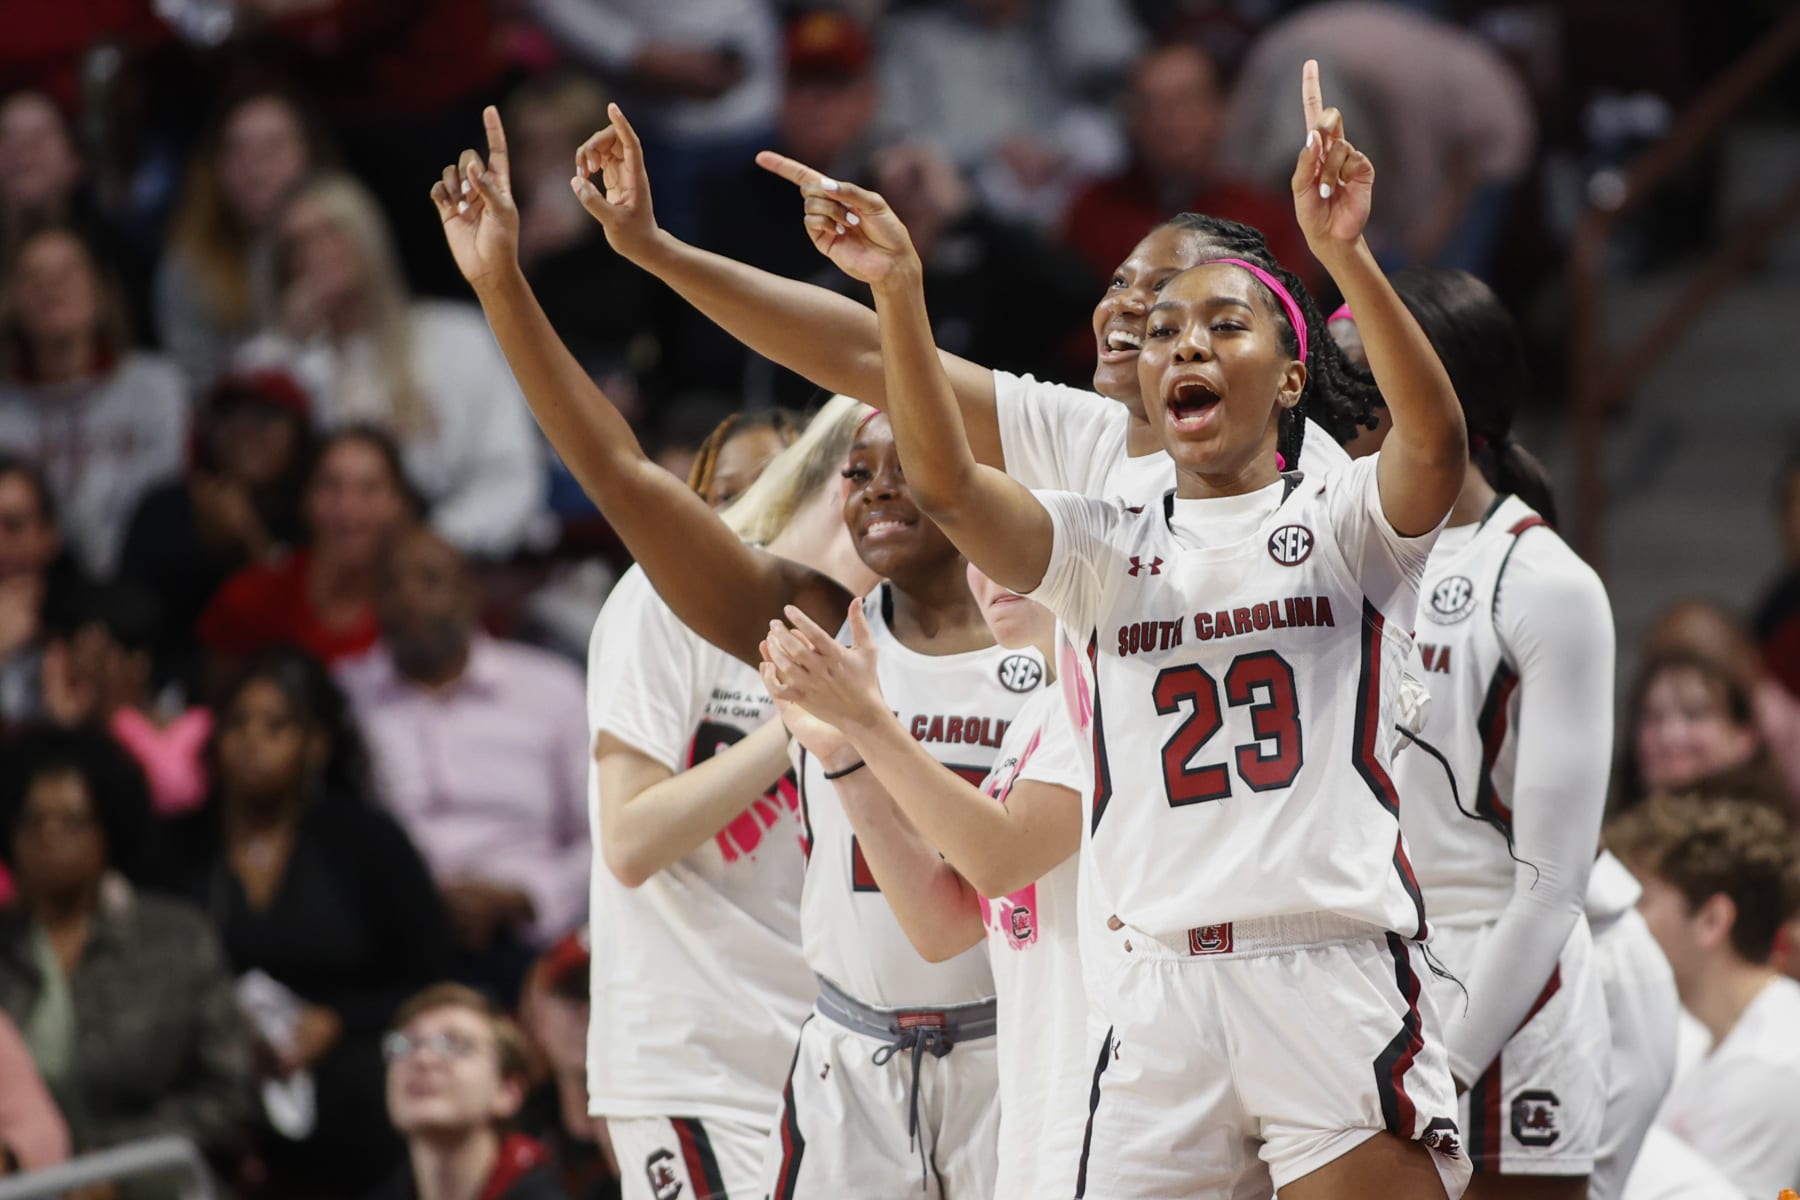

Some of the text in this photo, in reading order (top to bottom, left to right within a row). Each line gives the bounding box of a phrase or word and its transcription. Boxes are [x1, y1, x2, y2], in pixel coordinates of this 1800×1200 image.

[1269, 526, 1313, 565] SEC
[1432, 577, 1472, 614] SEC
[1118, 597, 1335, 657] SOUTH CAROLINA
[999, 655, 1042, 692] SEC
[910, 715, 1011, 749] CAROLI
[1152, 649, 1303, 808] 23
